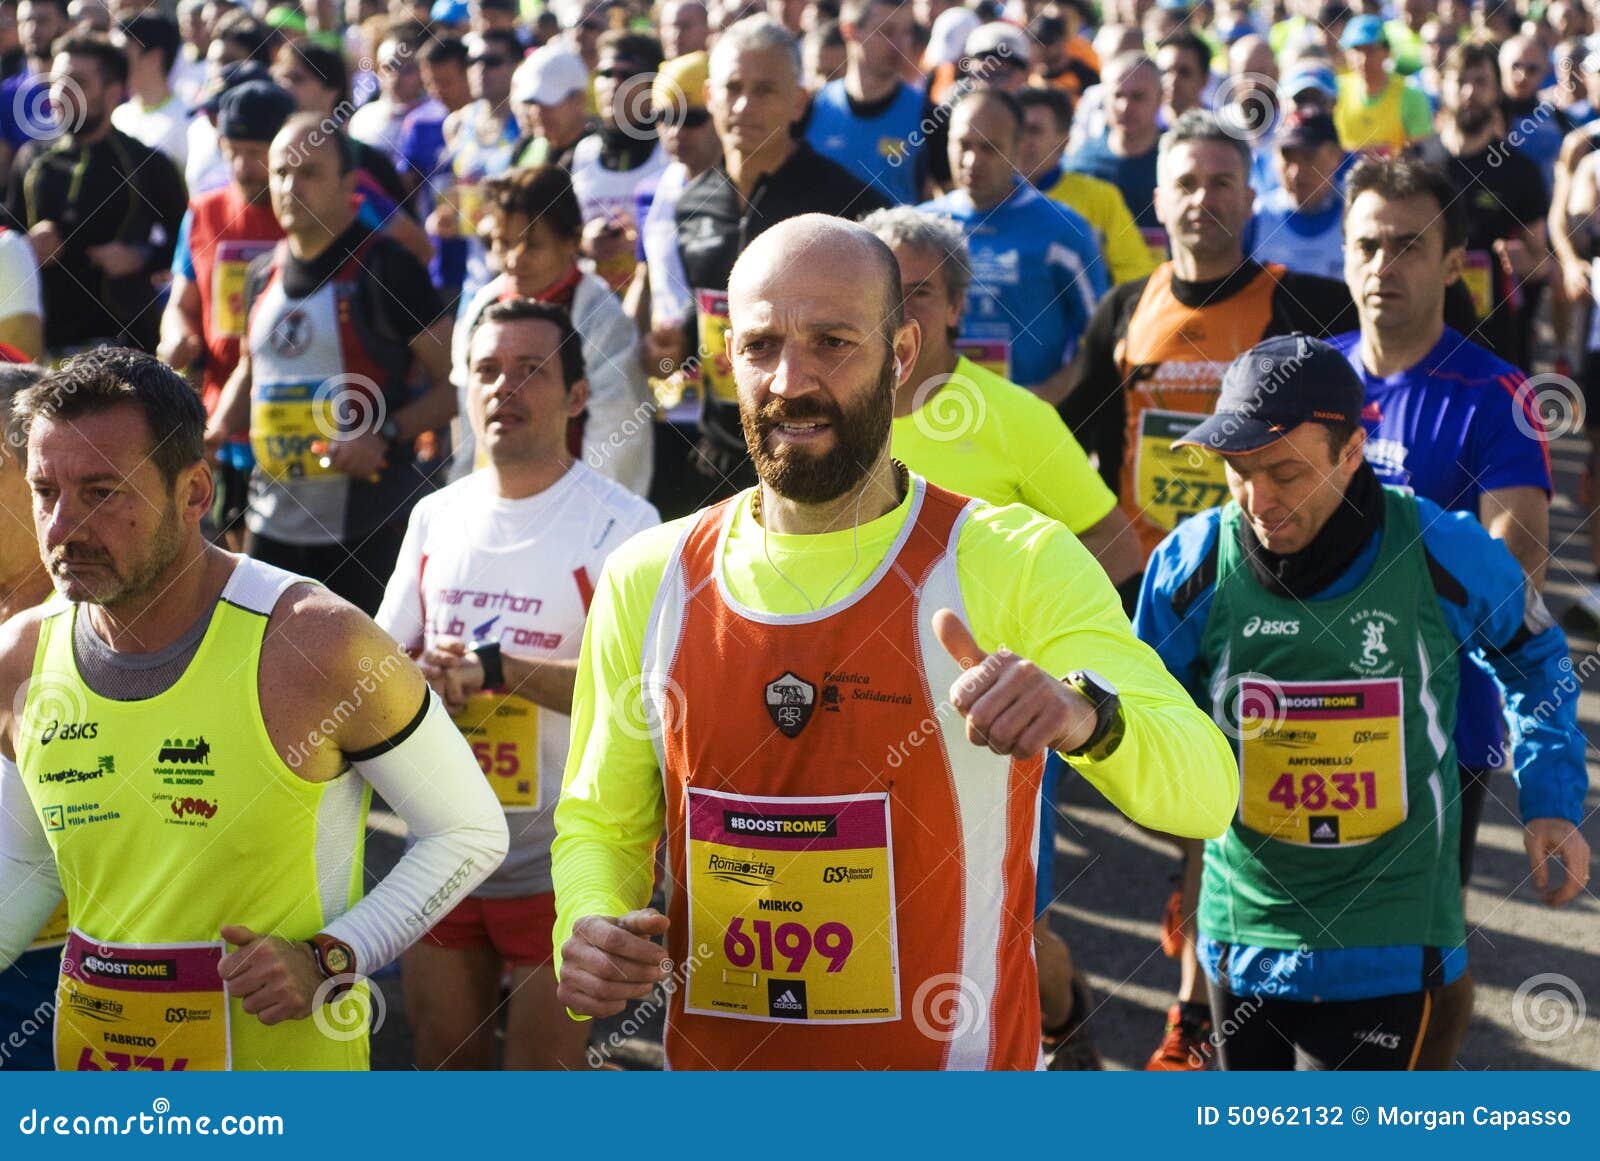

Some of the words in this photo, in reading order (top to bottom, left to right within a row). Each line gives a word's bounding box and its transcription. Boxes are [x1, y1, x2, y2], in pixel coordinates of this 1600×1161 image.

[1260, 620, 1300, 635] asics
[502, 626, 563, 650] roma
[59, 721, 99, 741] asics
[1268, 771, 1377, 812] 4831
[731, 817, 827, 833] #BOOSTROME
[758, 898, 803, 913] MIRKO
[723, 916, 854, 974] 6199
[773, 1001, 803, 1010] adidas
[103, 1031, 157, 1048] FABRIZIO
